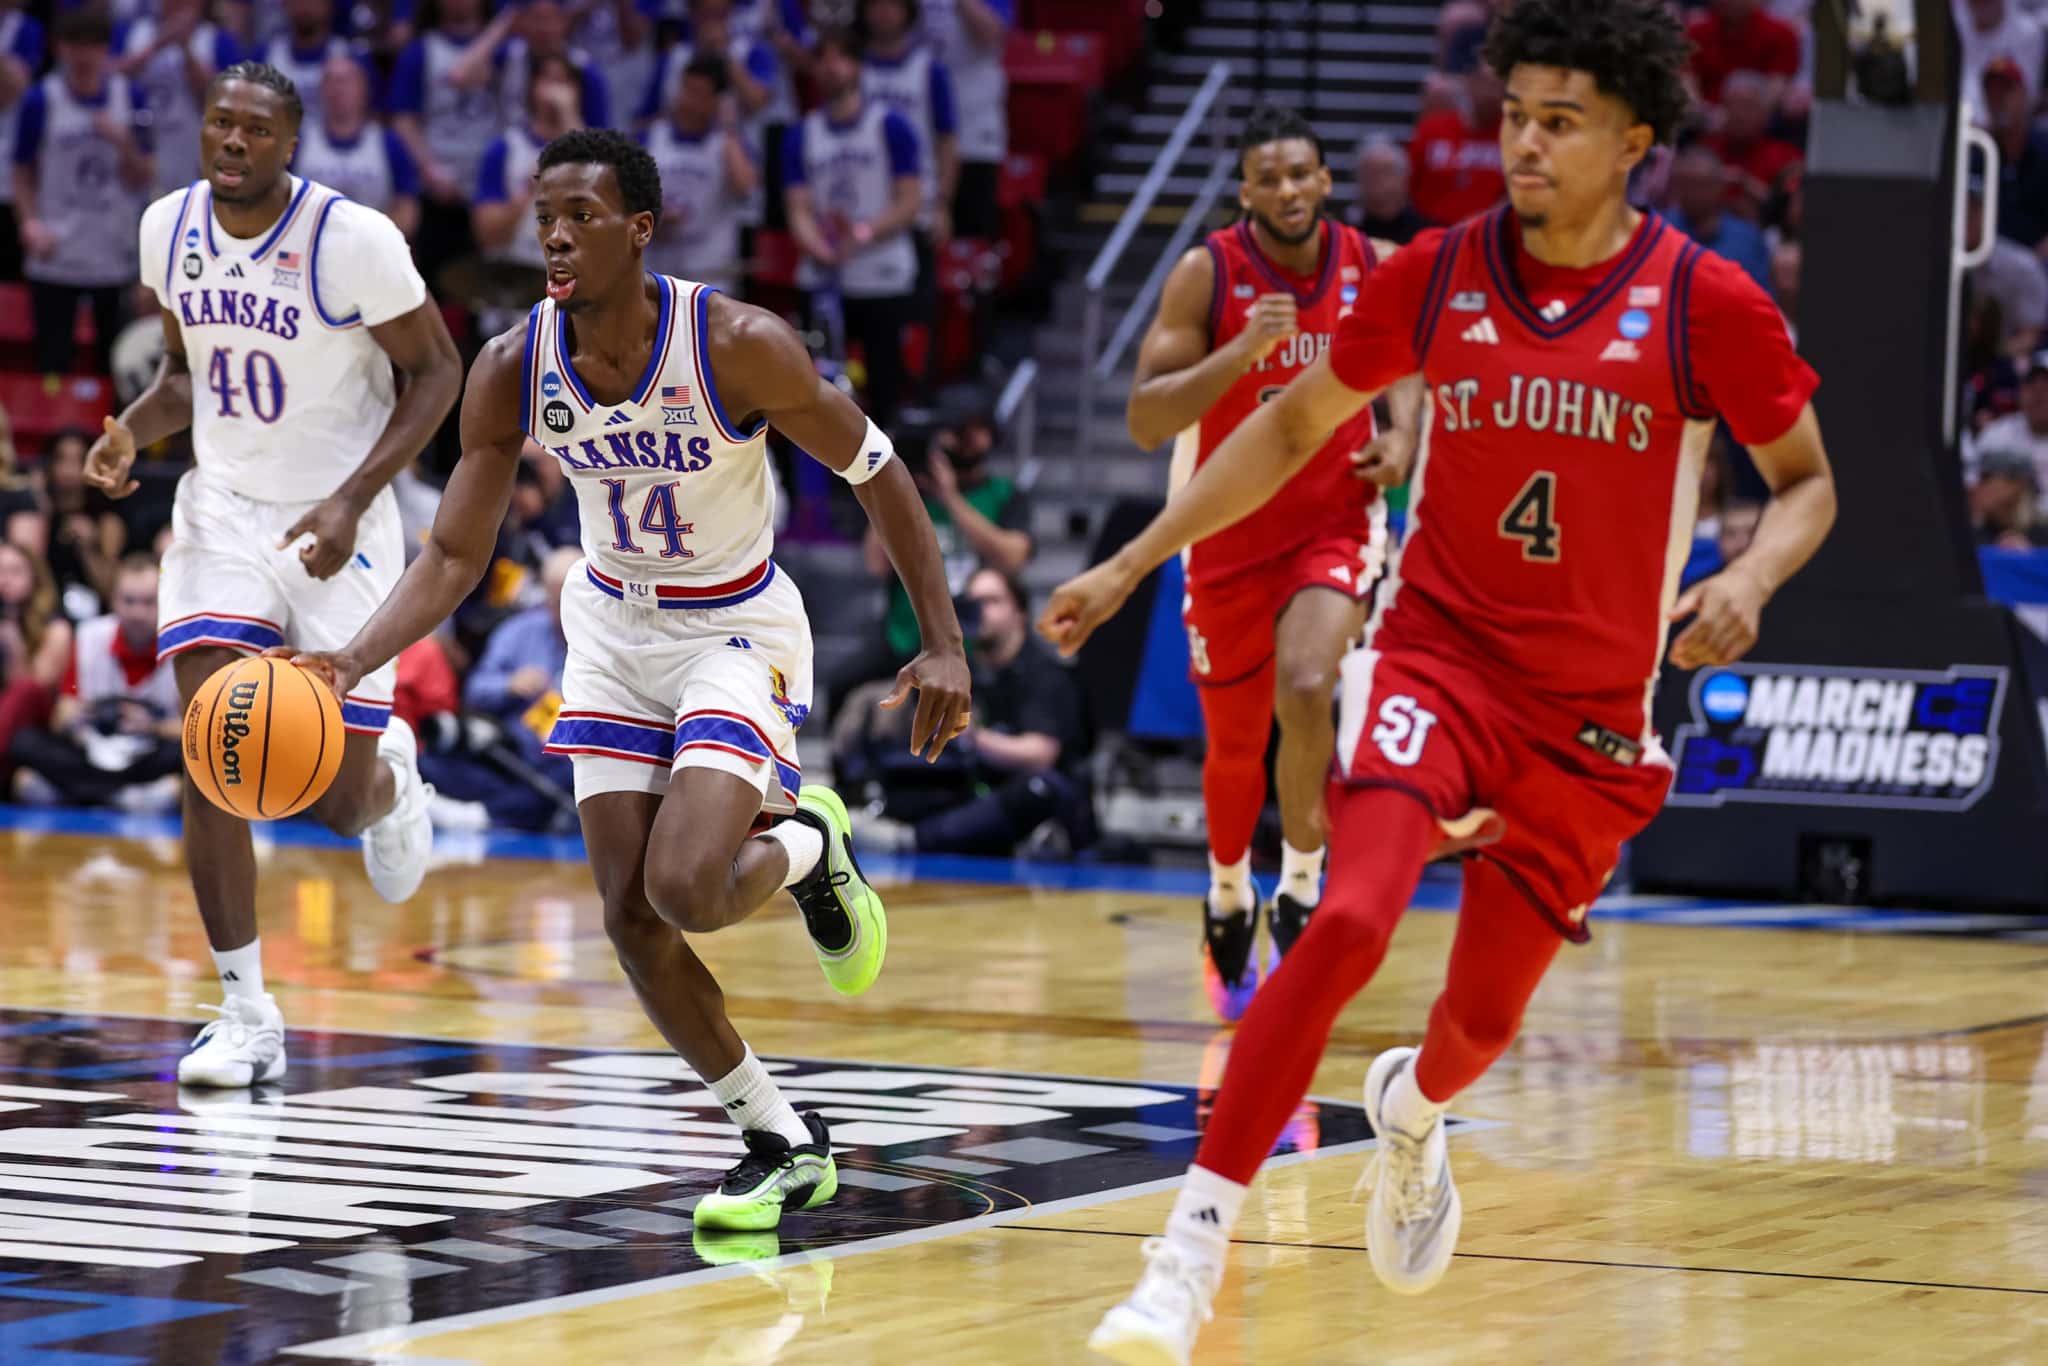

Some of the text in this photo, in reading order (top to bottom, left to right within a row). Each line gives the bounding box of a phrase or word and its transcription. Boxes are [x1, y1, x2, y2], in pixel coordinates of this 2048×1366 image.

[178, 288, 302, 341] KANSAS
[208, 345, 288, 424] 40
[663, 407, 695, 424] XII
[1437, 373, 1654, 452] ST. JOHN'S
[547, 409, 569, 427] SW
[552, 430, 713, 473] KANSAS
[600, 478, 695, 559] 14
[1498, 469, 1561, 563] 4
[628, 582, 649, 596] KU
[223, 680, 259, 787] Wilson
[1372, 693, 1438, 766] SJ
[1745, 674, 1916, 731] MARCH
[1762, 725, 1988, 787] MADNESS
